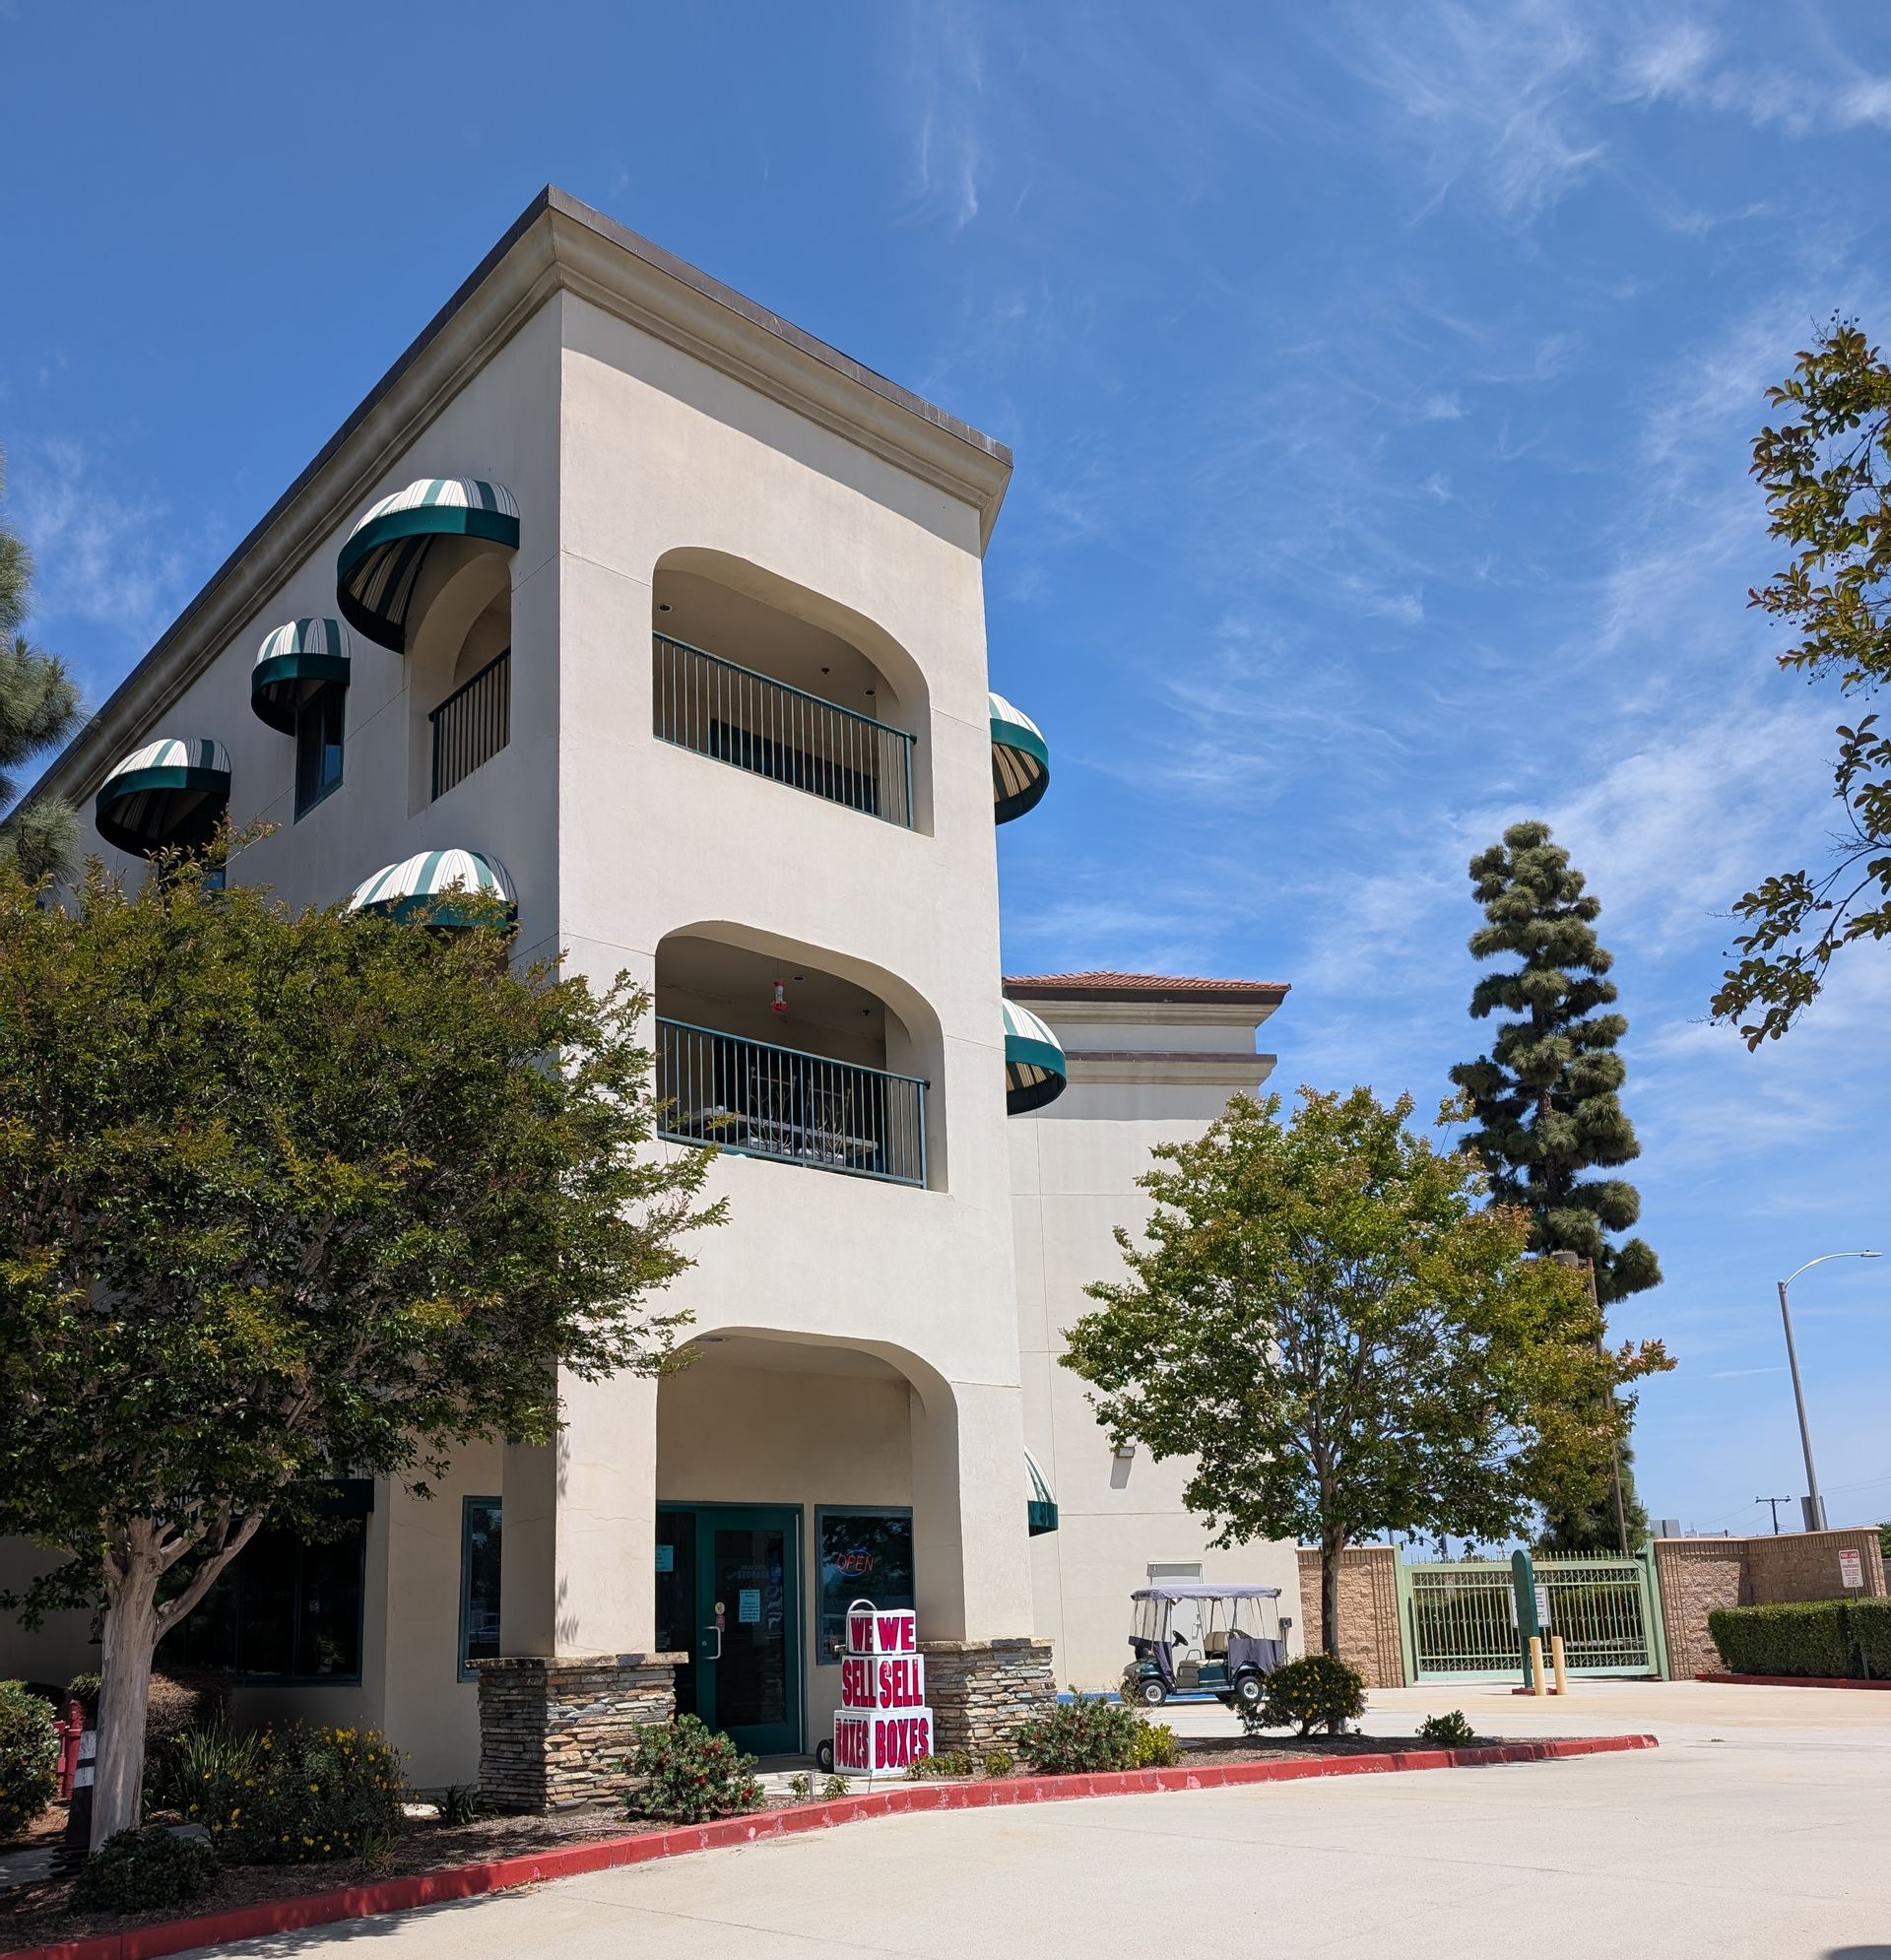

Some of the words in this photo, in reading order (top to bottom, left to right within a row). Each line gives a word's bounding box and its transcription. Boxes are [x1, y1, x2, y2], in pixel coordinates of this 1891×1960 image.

[837, 1555, 874, 1571] OPEN
[850, 1617, 873, 1651] WE
[877, 1616, 915, 1651] WE
[842, 1660, 877, 1708] SELL
[879, 1660, 923, 1709] SELL
[835, 1718, 869, 1769] BOXES
[875, 1717, 930, 1769] BOXES
